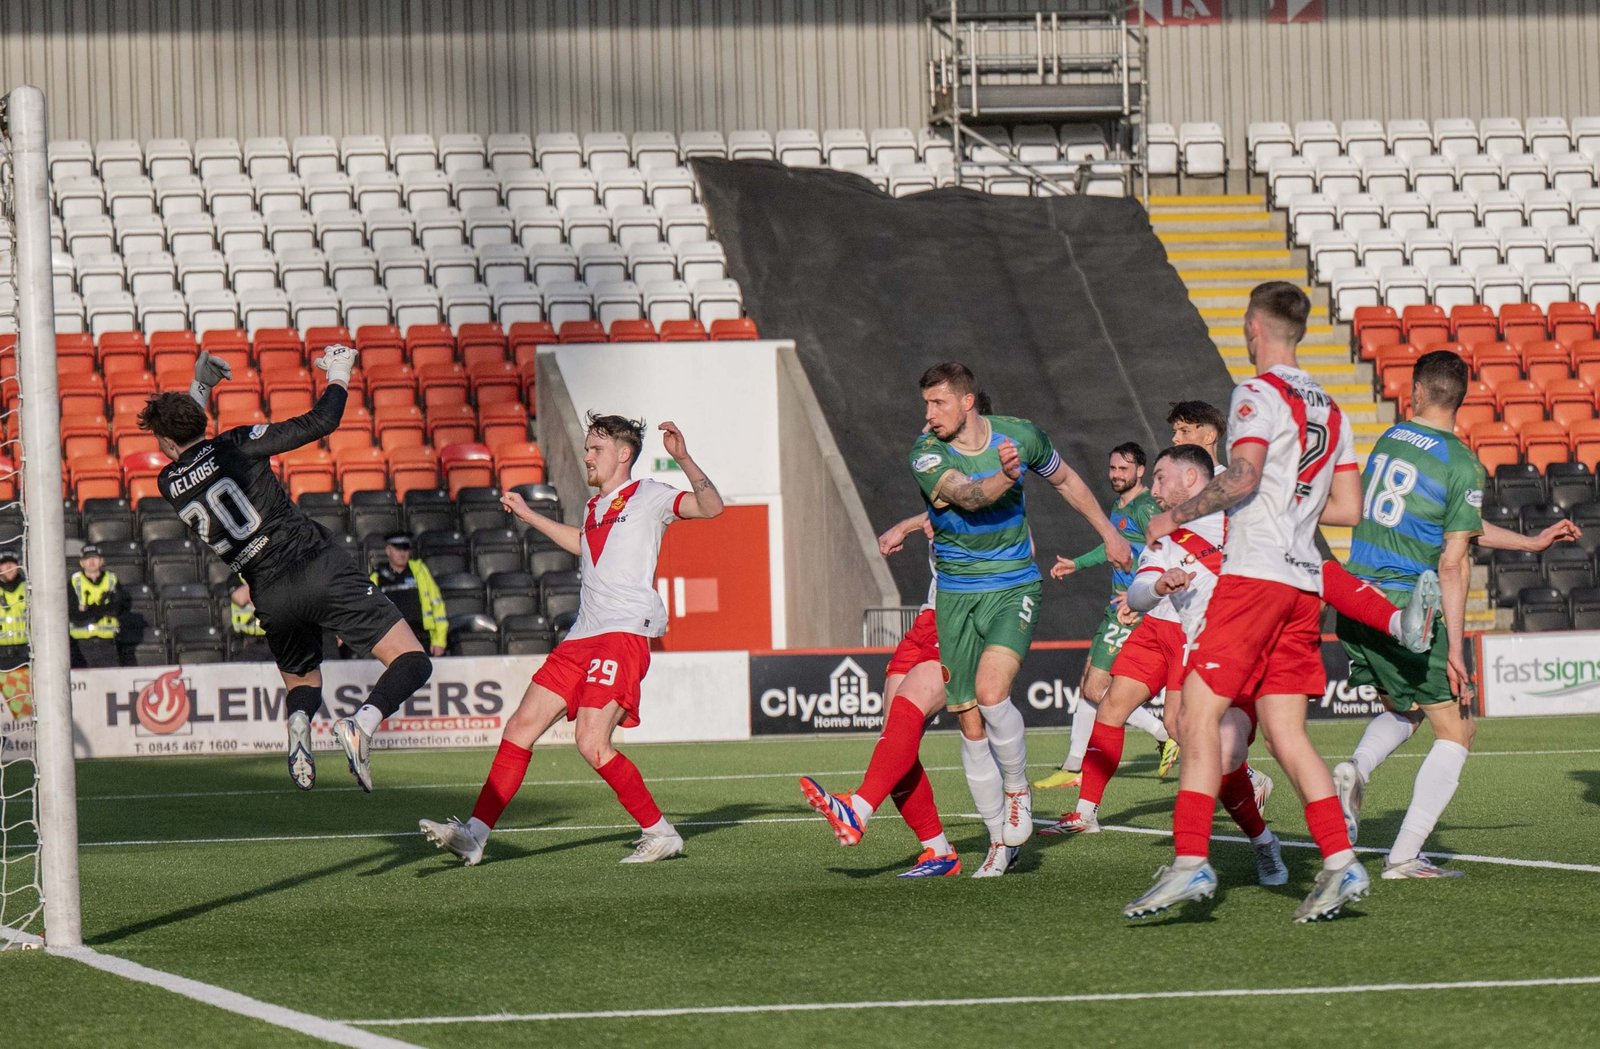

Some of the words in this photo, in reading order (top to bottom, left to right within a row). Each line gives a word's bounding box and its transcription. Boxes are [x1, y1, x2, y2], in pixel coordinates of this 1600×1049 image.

[169, 456, 220, 499] MELROSE
[1362, 453, 1418, 528] 18
[179, 476, 262, 555] 20
[1018, 595, 1035, 623] 5
[1103, 621, 1132, 648] 22
[586, 658, 619, 687] 29
[760, 656, 884, 722] Clydeb
[1027, 679, 1081, 714] Cly
[813, 715, 851, 729] Home
[852, 714, 884, 729] Impr
[1333, 701, 1369, 714] Home
[1371, 701, 1386, 713] Im
[388, 717, 496, 730] Protection
[149, 742, 178, 753] 0845
[183, 741, 204, 752] 467
[209, 740, 238, 751] 1600
